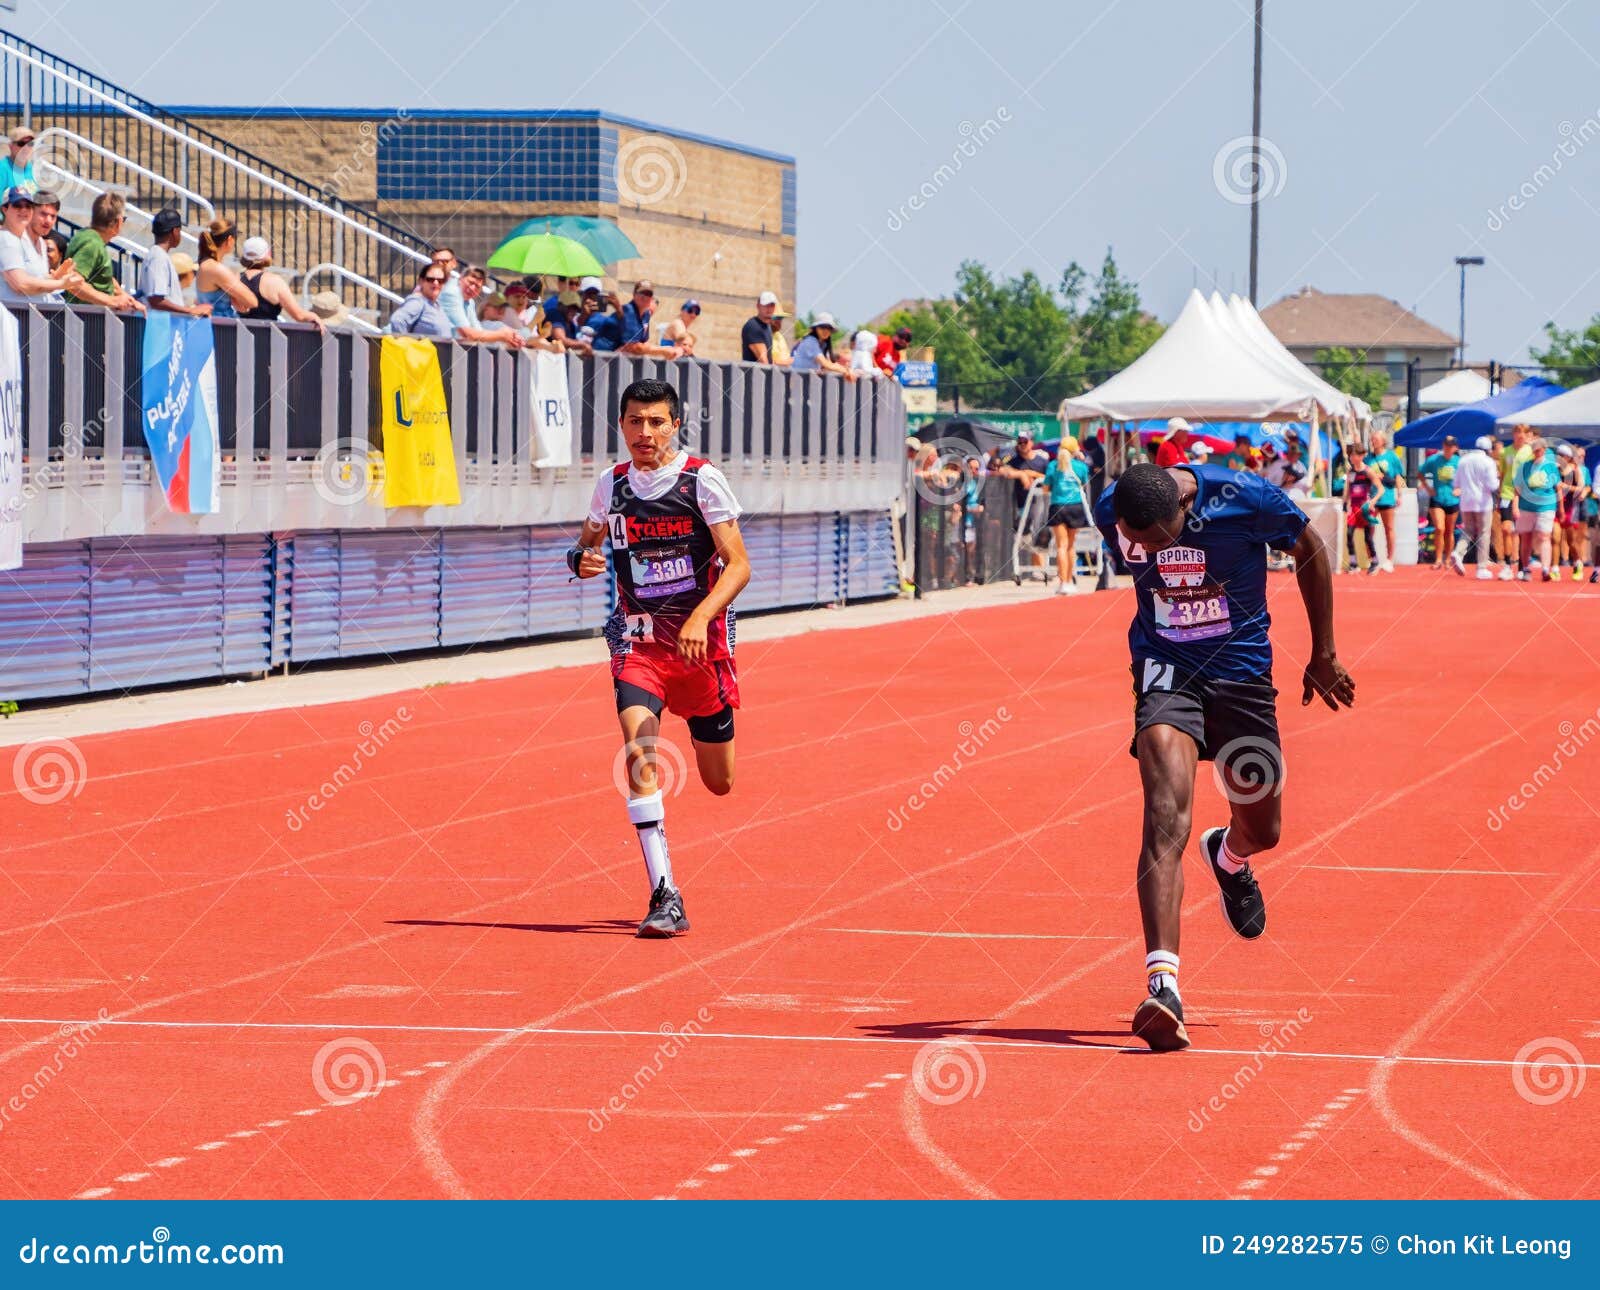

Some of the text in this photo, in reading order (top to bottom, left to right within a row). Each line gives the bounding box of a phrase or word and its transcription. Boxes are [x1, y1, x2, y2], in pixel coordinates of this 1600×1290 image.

[614, 515, 625, 546] 4
[1160, 549, 1203, 564] SPORTS
[652, 558, 688, 582] 330
[1178, 598, 1222, 624] 328
[631, 616, 645, 642] 4
[1147, 661, 1167, 691] 2
